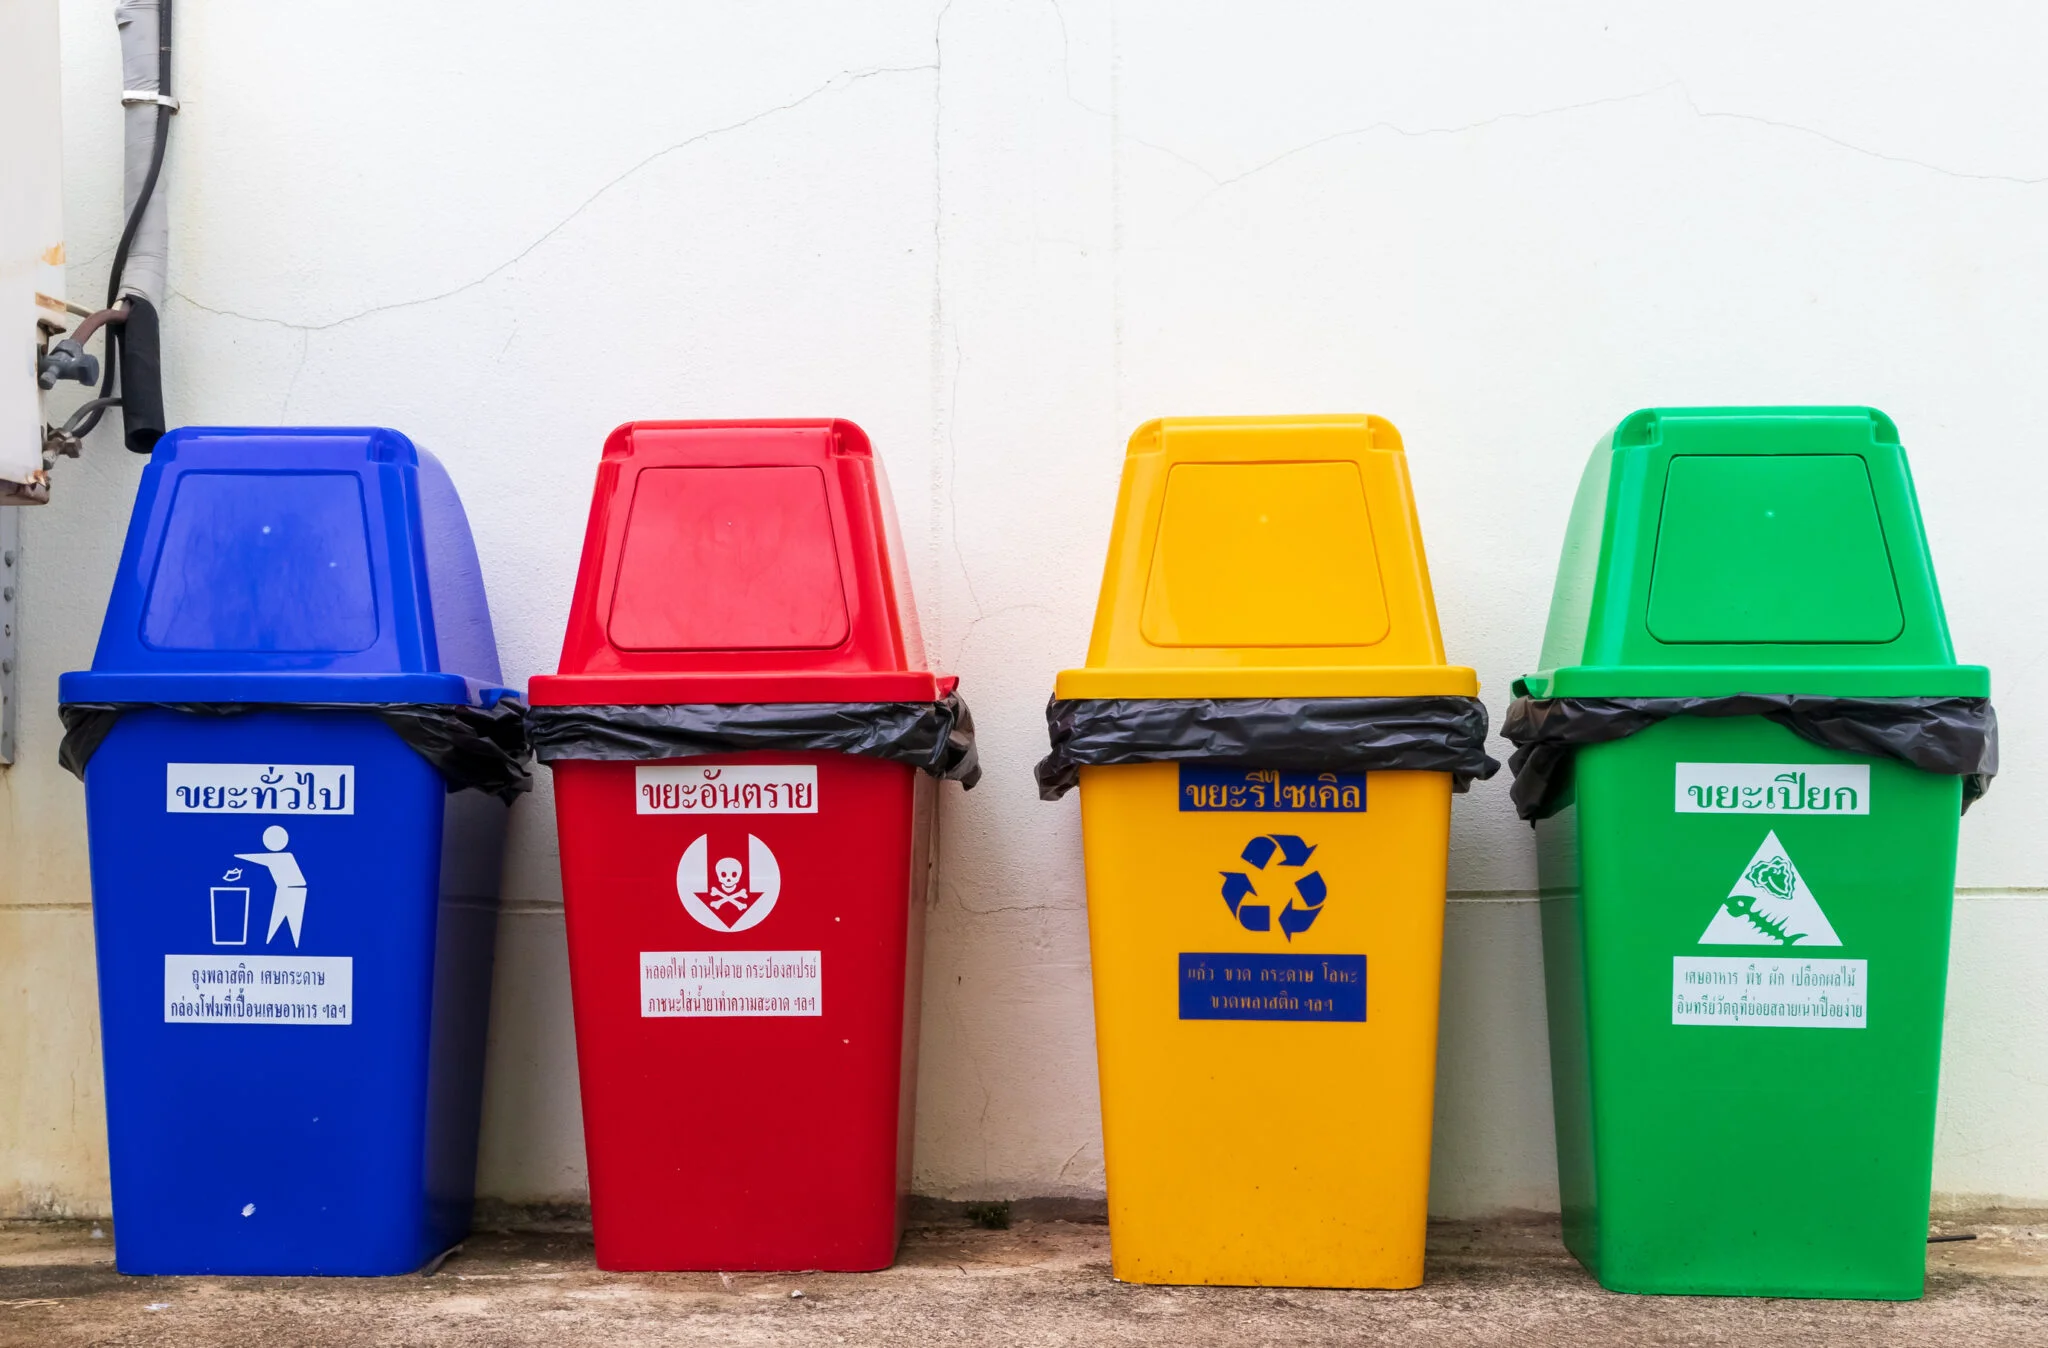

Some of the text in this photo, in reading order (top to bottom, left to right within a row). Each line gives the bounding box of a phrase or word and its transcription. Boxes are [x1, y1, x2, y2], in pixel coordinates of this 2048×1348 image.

[176, 766, 346, 810] ขยะทั่วไป
[642, 769, 812, 809] ขยะอันตราย
[1186, 769, 1361, 808] ขยะรีไซเคิล
[1687, 771, 1858, 810] ขยะเปียก
[192, 962, 326, 990] ถุงพลาสติก เศษกระดาษ
[645, 957, 686, 980] หลอดไฟ
[691, 956, 742, 980] ถ่านไฟฉาย
[1223, 967, 1252, 981] ขวด
[1260, 968, 1314, 982] กระดาษ
[1321, 961, 1358, 983] โลหะ
[1684, 963, 1857, 987] เศษอาหาร พืช ผัก เปลือกผลไม้
[171, 988, 346, 1019] กล่องโฟมที่เปื้อนเศษอาหาร ฯลฯ
[647, 985, 815, 1012] ภาชนะใส่น้ำยาทำความสะอาด ฯลฯ
[1211, 990, 1333, 1012] ขวดพลาสติก ฯลฯ
